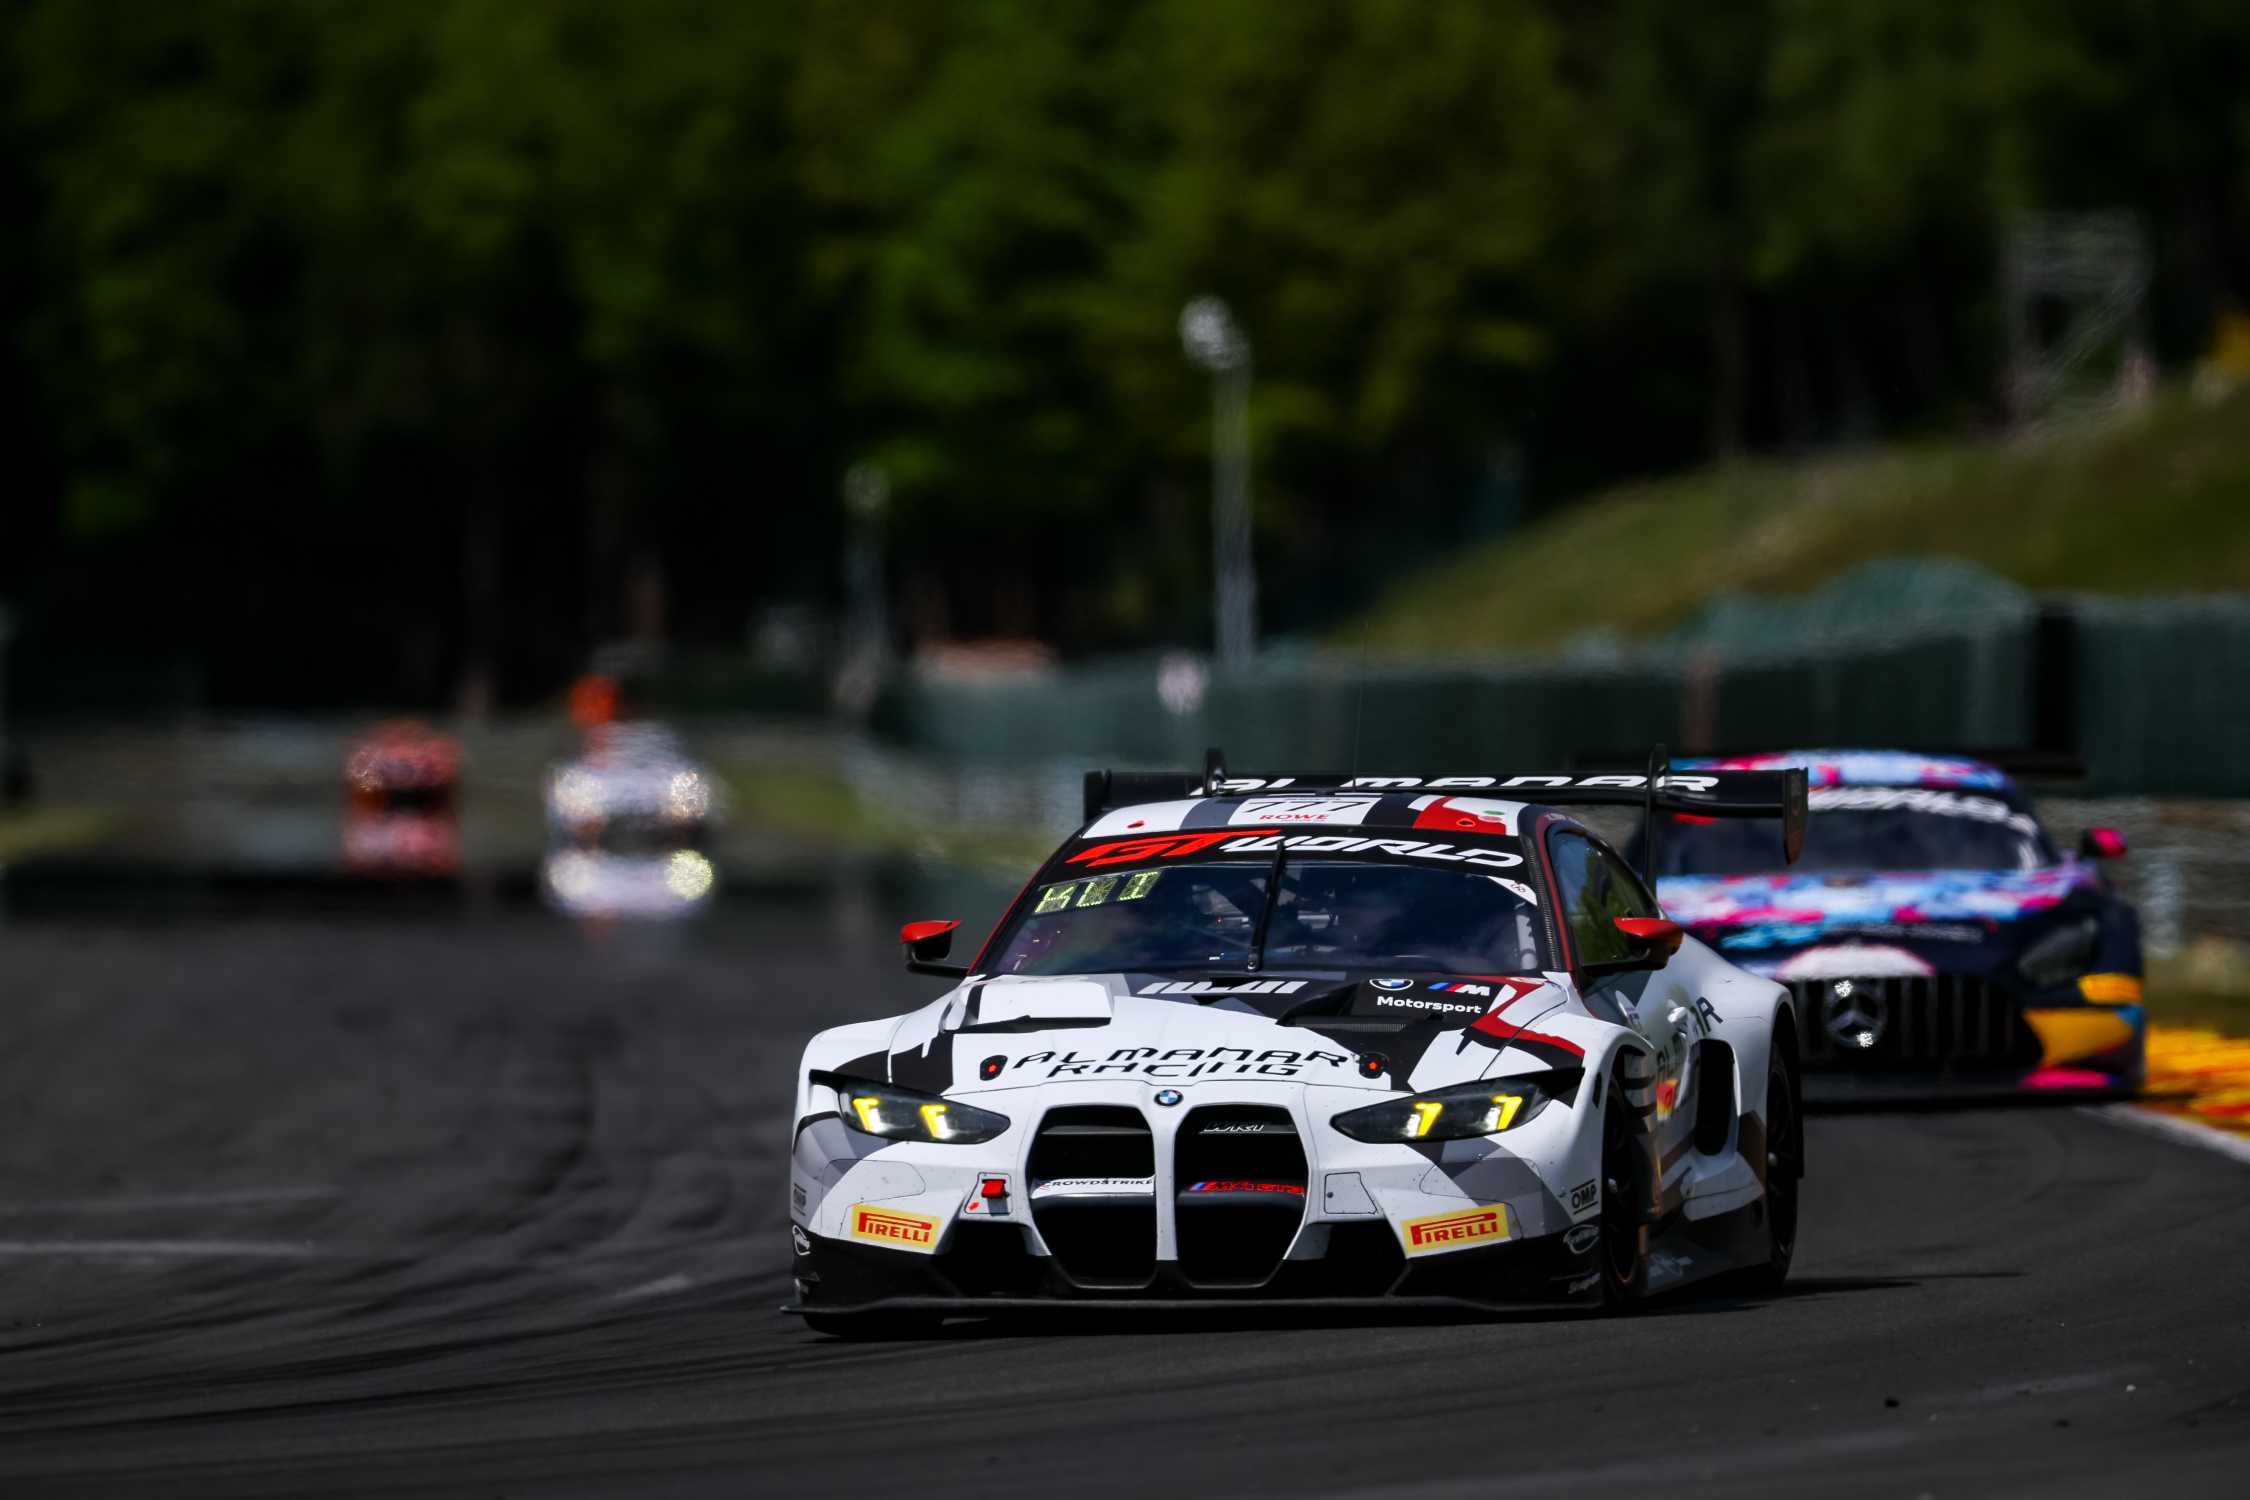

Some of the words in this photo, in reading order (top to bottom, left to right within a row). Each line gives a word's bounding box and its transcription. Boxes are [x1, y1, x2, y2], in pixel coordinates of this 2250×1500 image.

[1218, 836, 1524, 868] WORLD
[1376, 996, 1482, 1014] Motorsport
[1012, 1050, 1097, 1069] AL
[1106, 1047, 1348, 1068] MANAR
[1046, 1061, 1303, 1078] RACING
[1047, 1179, 1153, 1187] ROWDSTRIKE
[1571, 1184, 1597, 1209] OMP
[858, 1211, 933, 1243] PIRELLI
[1410, 1212, 1498, 1245] PIRELLI
